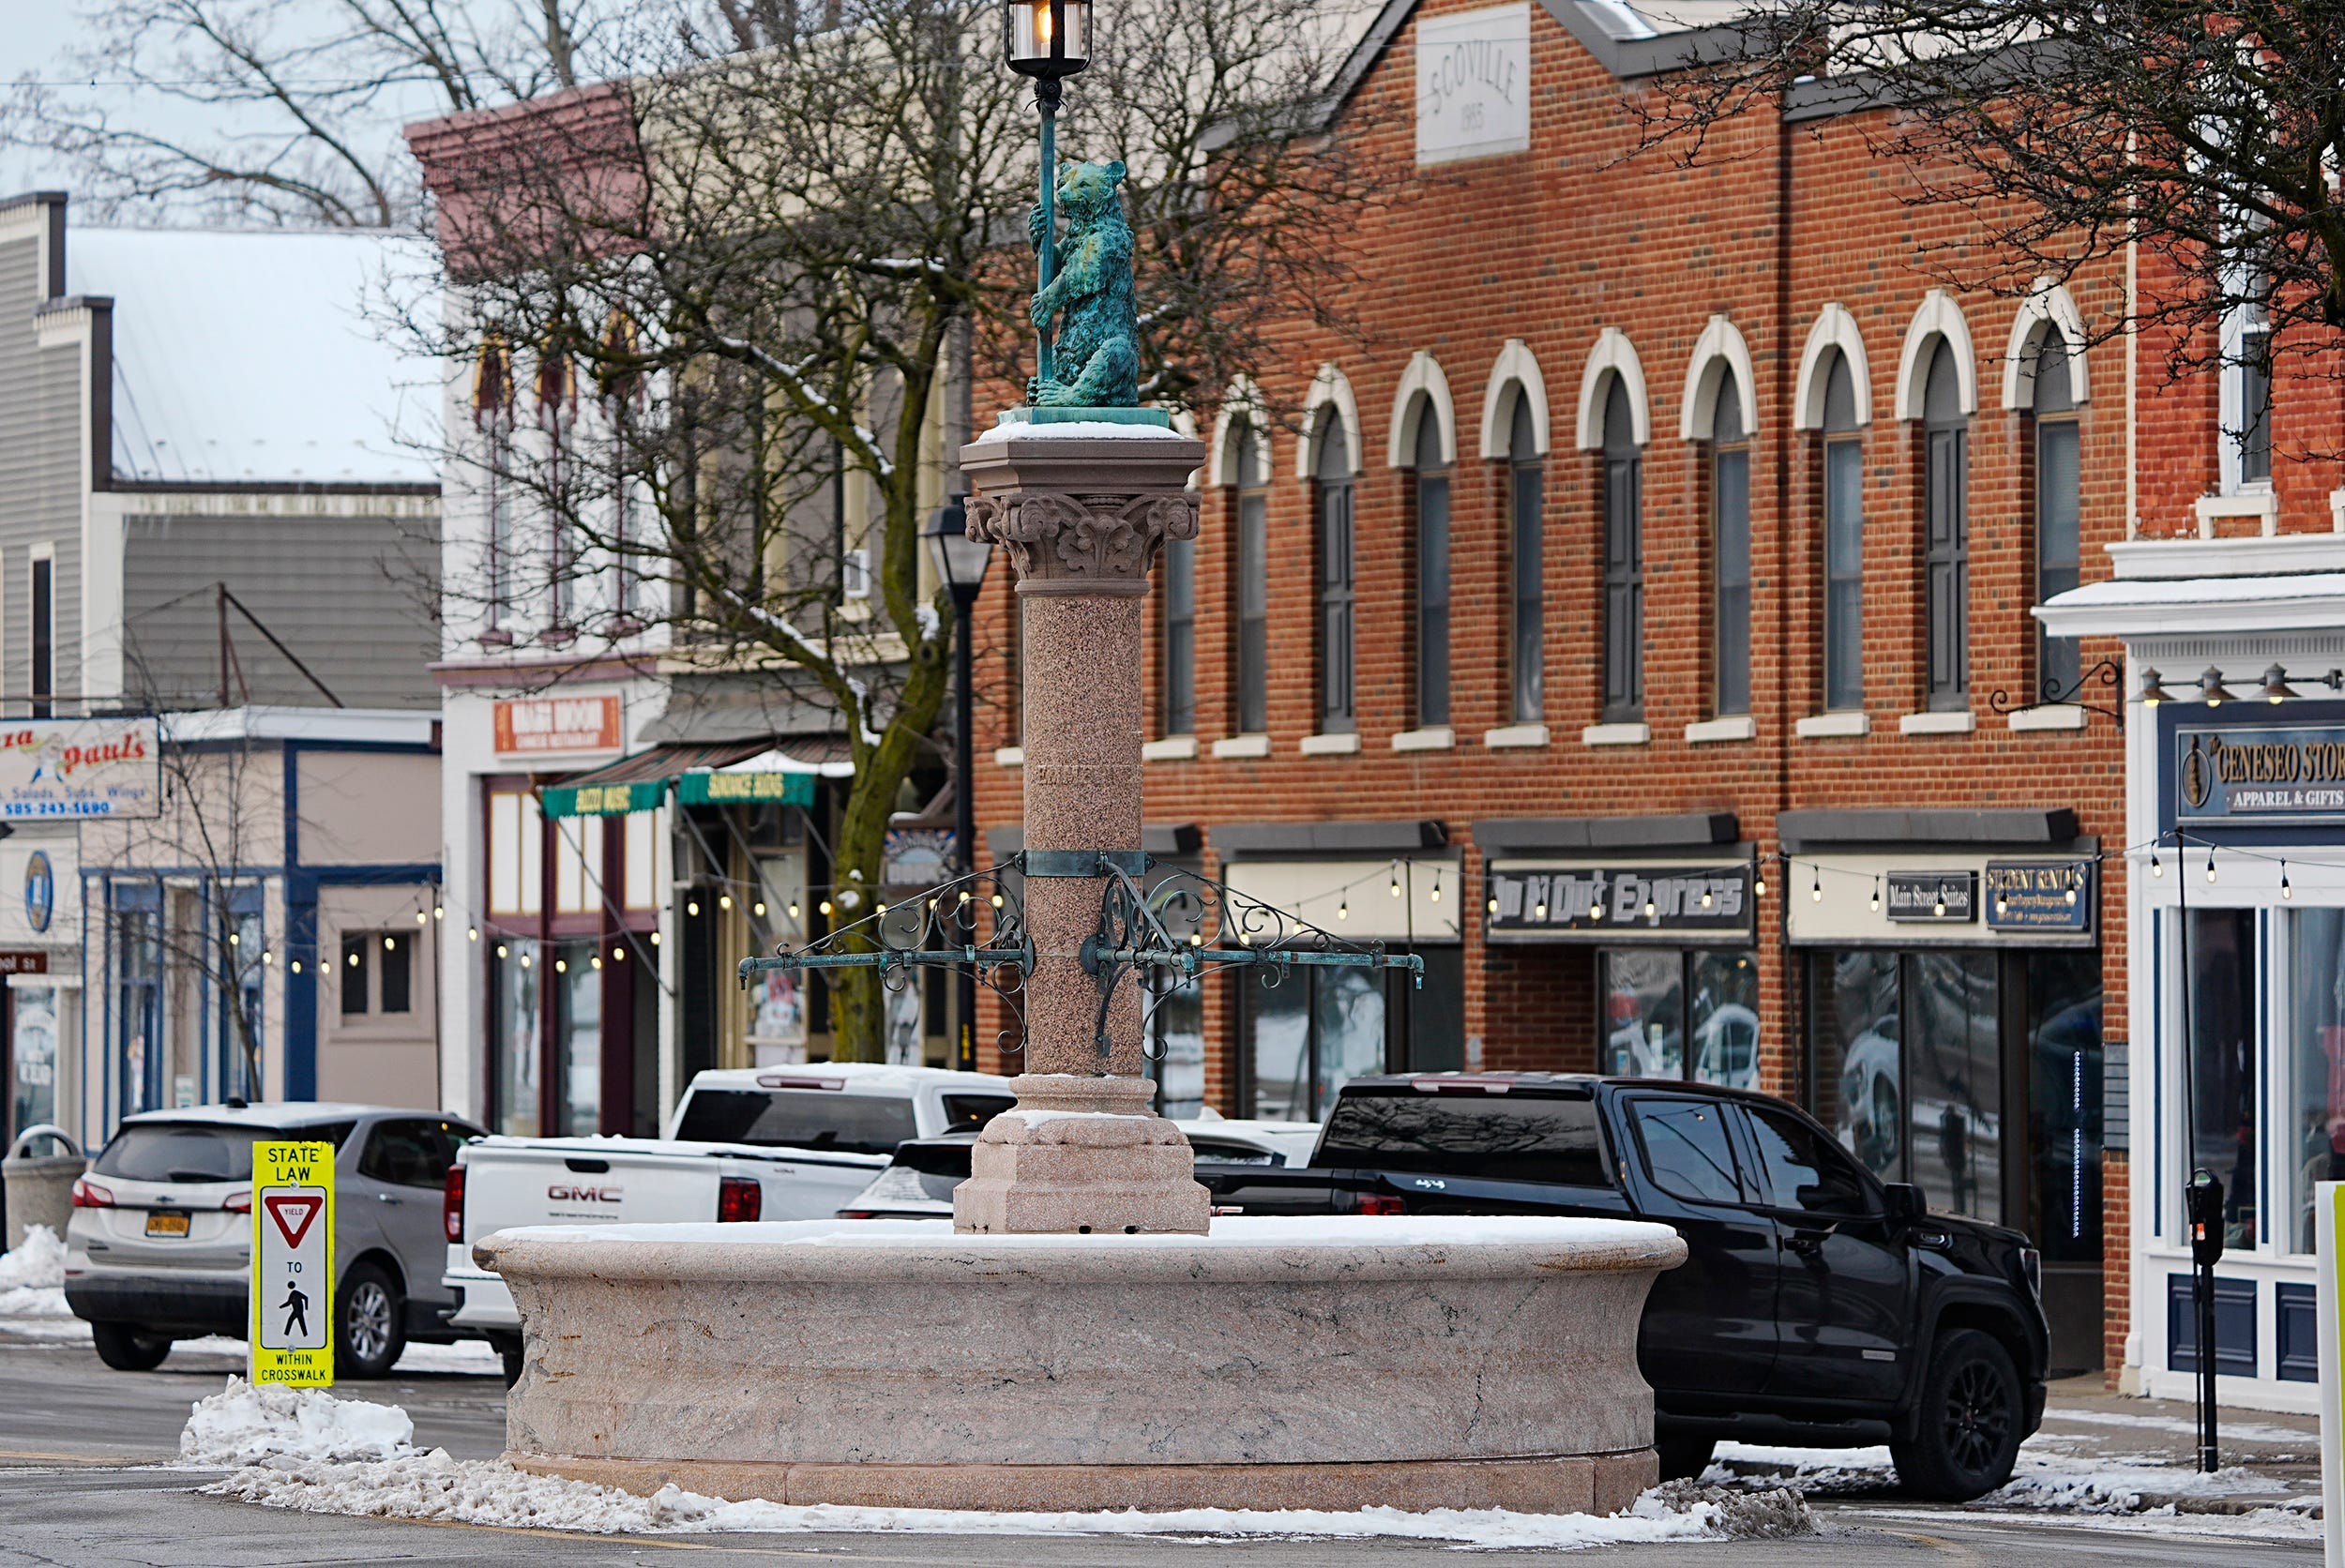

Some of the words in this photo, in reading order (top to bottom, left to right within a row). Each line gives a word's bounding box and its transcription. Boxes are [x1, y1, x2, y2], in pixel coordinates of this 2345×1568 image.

[1431, 38, 1516, 115] SCOVILLE
[65, 729, 145, 775] Paul's
[2216, 745, 2300, 783] GENESEO
[2233, 792, 2292, 807] APPAREL
[2294, 790, 2304, 806] &
[2305, 790, 2344, 807] GIFTS
[1988, 868, 2035, 890] STUDENT
[1551, 869, 1607, 922] Out
[1611, 874, 1743, 927] Express
[1890, 884, 1912, 907] Main
[1914, 884, 1939, 907] Street
[1941, 884, 1968, 907] Suites
[268, 1148, 319, 1163] STATE
[277, 1167, 310, 1182] LAW
[548, 1185, 623, 1202] GMC
[284, 1207, 304, 1216] YIELD
[287, 1262, 302, 1274] TO
[276, 1354, 312, 1365] WITHIN
[262, 1369, 325, 1381] CROSSWALK
